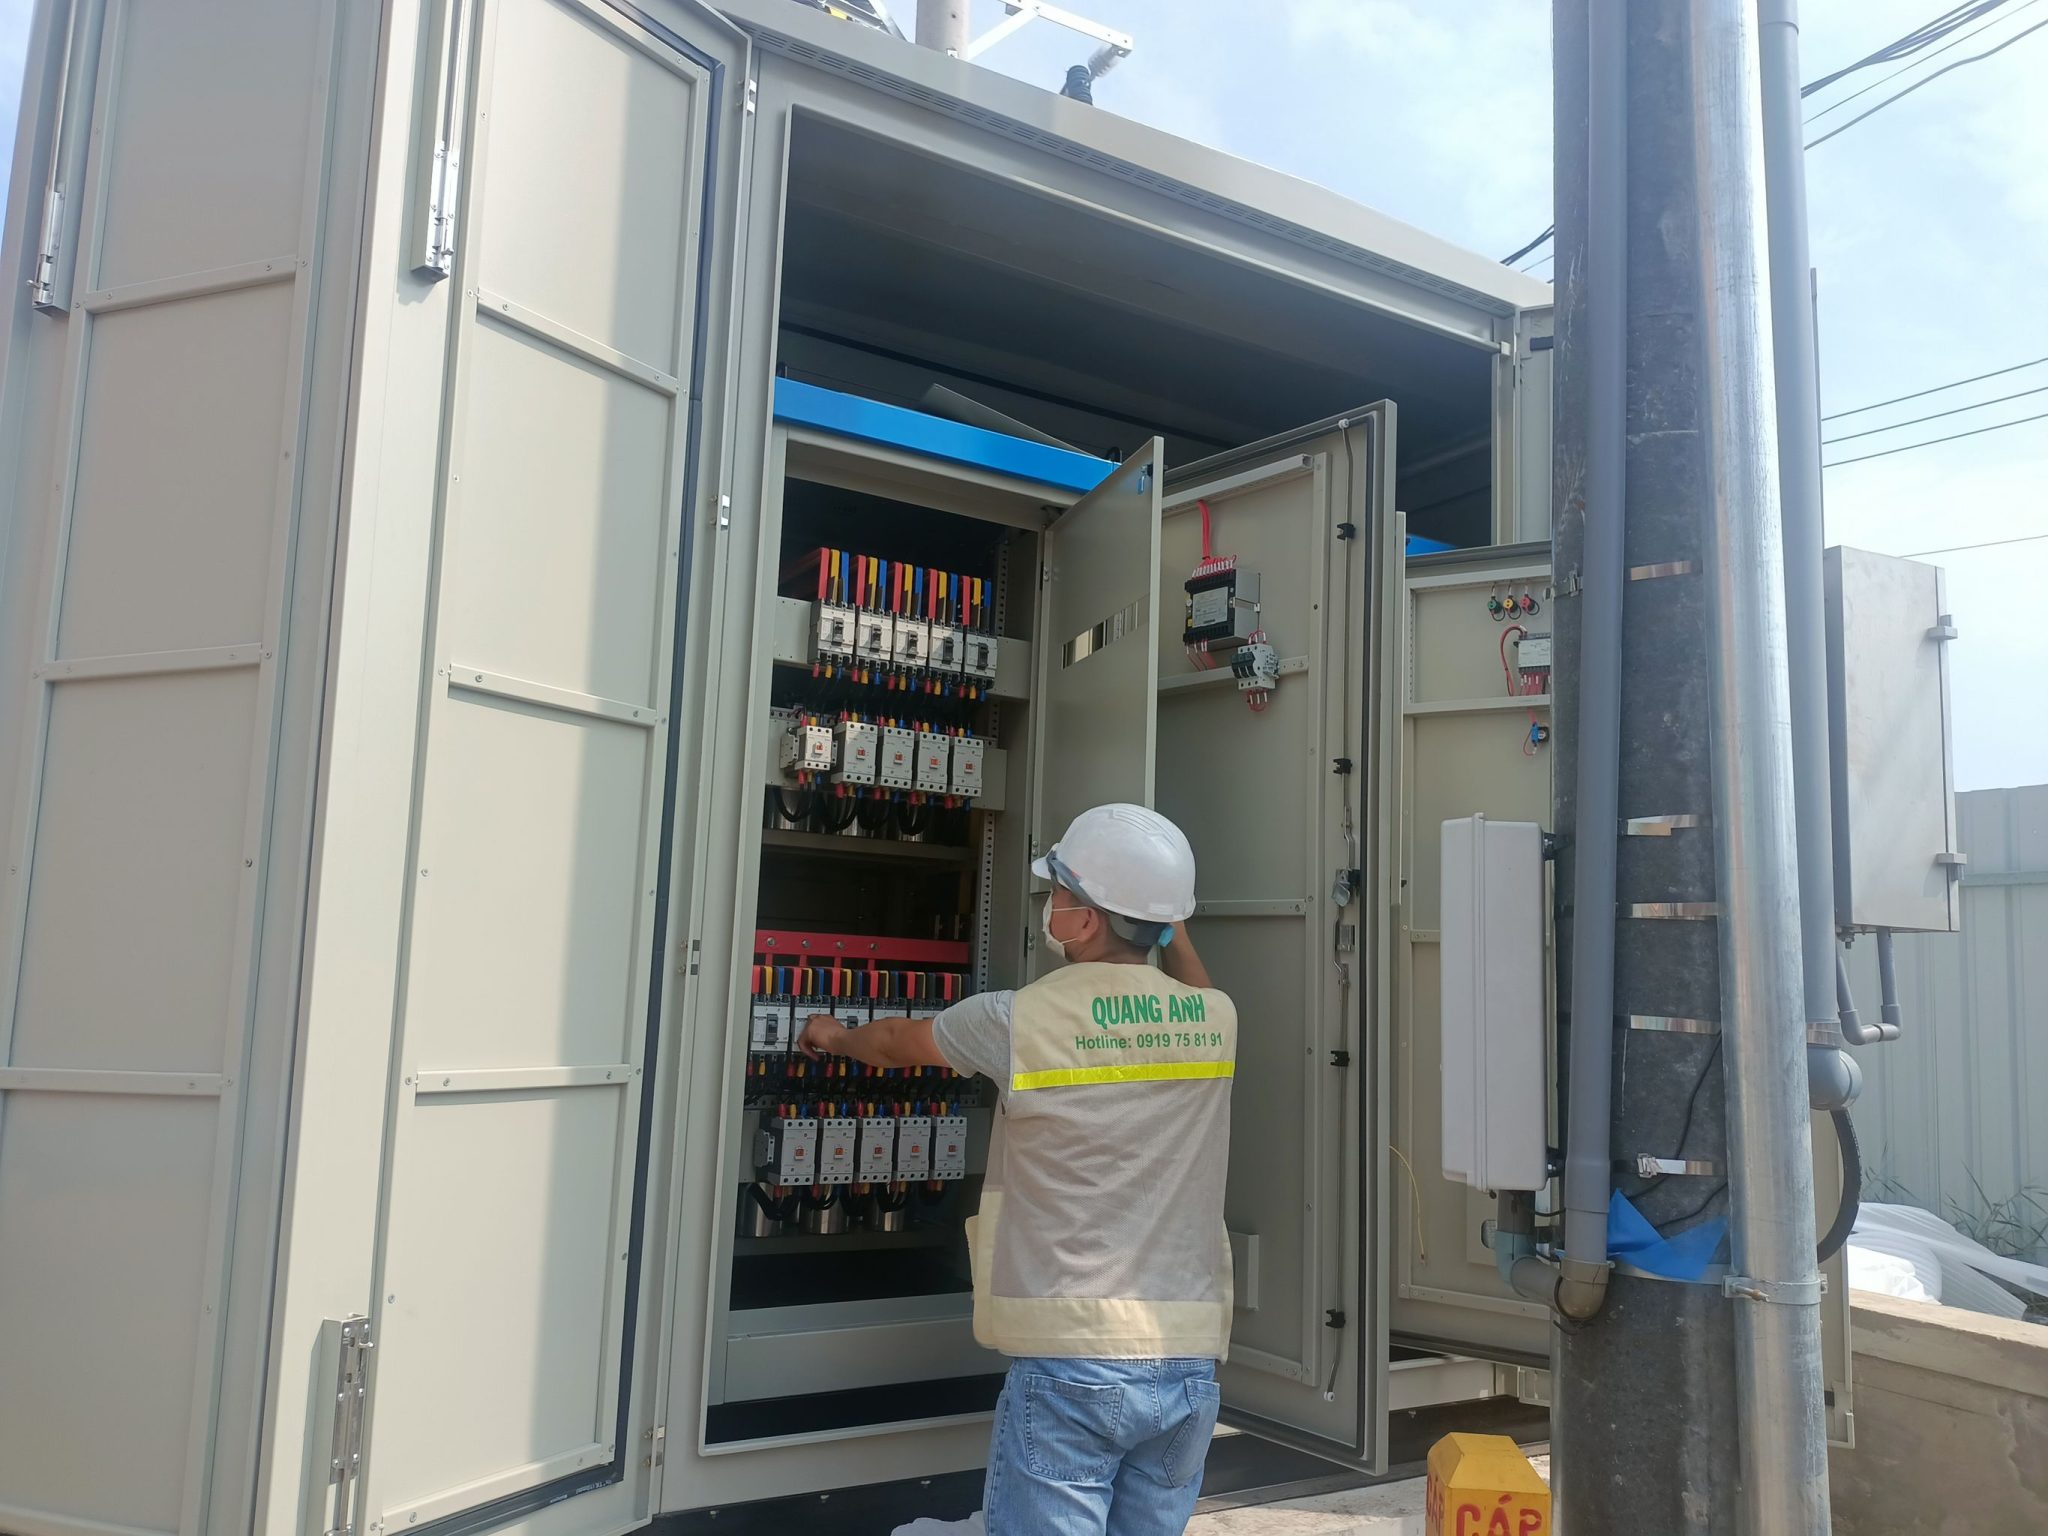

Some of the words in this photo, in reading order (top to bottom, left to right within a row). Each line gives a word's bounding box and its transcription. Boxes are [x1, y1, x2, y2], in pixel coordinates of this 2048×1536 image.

[1091, 994, 1163, 1030] QUANG
[1168, 993, 1206, 1023] ANH
[1075, 1034, 1132, 1050] Hotline:
[1136, 1032, 1171, 1048] 0919
[1175, 1032, 1191, 1047] 75
[1194, 1032, 1208, 1047] 81
[1210, 1032, 1223, 1047] 91
[1456, 1493, 1542, 1536] CÁP
